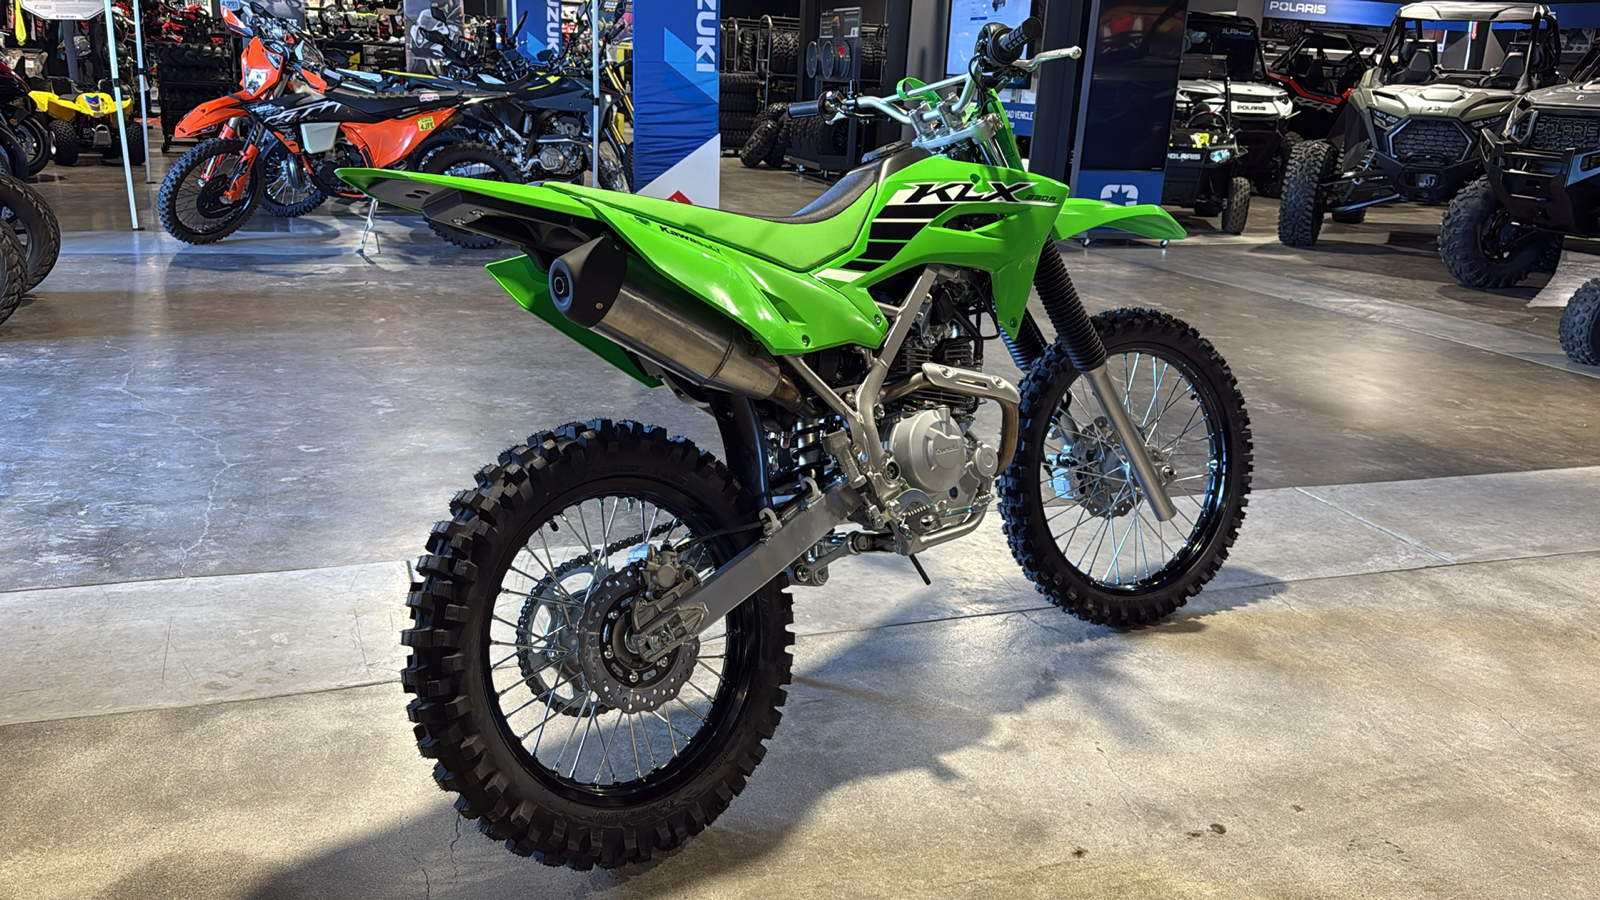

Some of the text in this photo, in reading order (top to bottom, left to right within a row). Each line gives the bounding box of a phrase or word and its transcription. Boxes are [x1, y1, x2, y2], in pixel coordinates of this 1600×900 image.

[1269, 1, 1326, 14] POLARIS
[546, 0, 559, 54] ZUK
[1293, 95, 1338, 113] RZR
[1015, 110, 1034, 120] VEHICLE
[1536, 122, 1598, 137] POLARIS
[904, 182, 1057, 203] KLX 230R
[659, 224, 724, 256] Kawasaki
